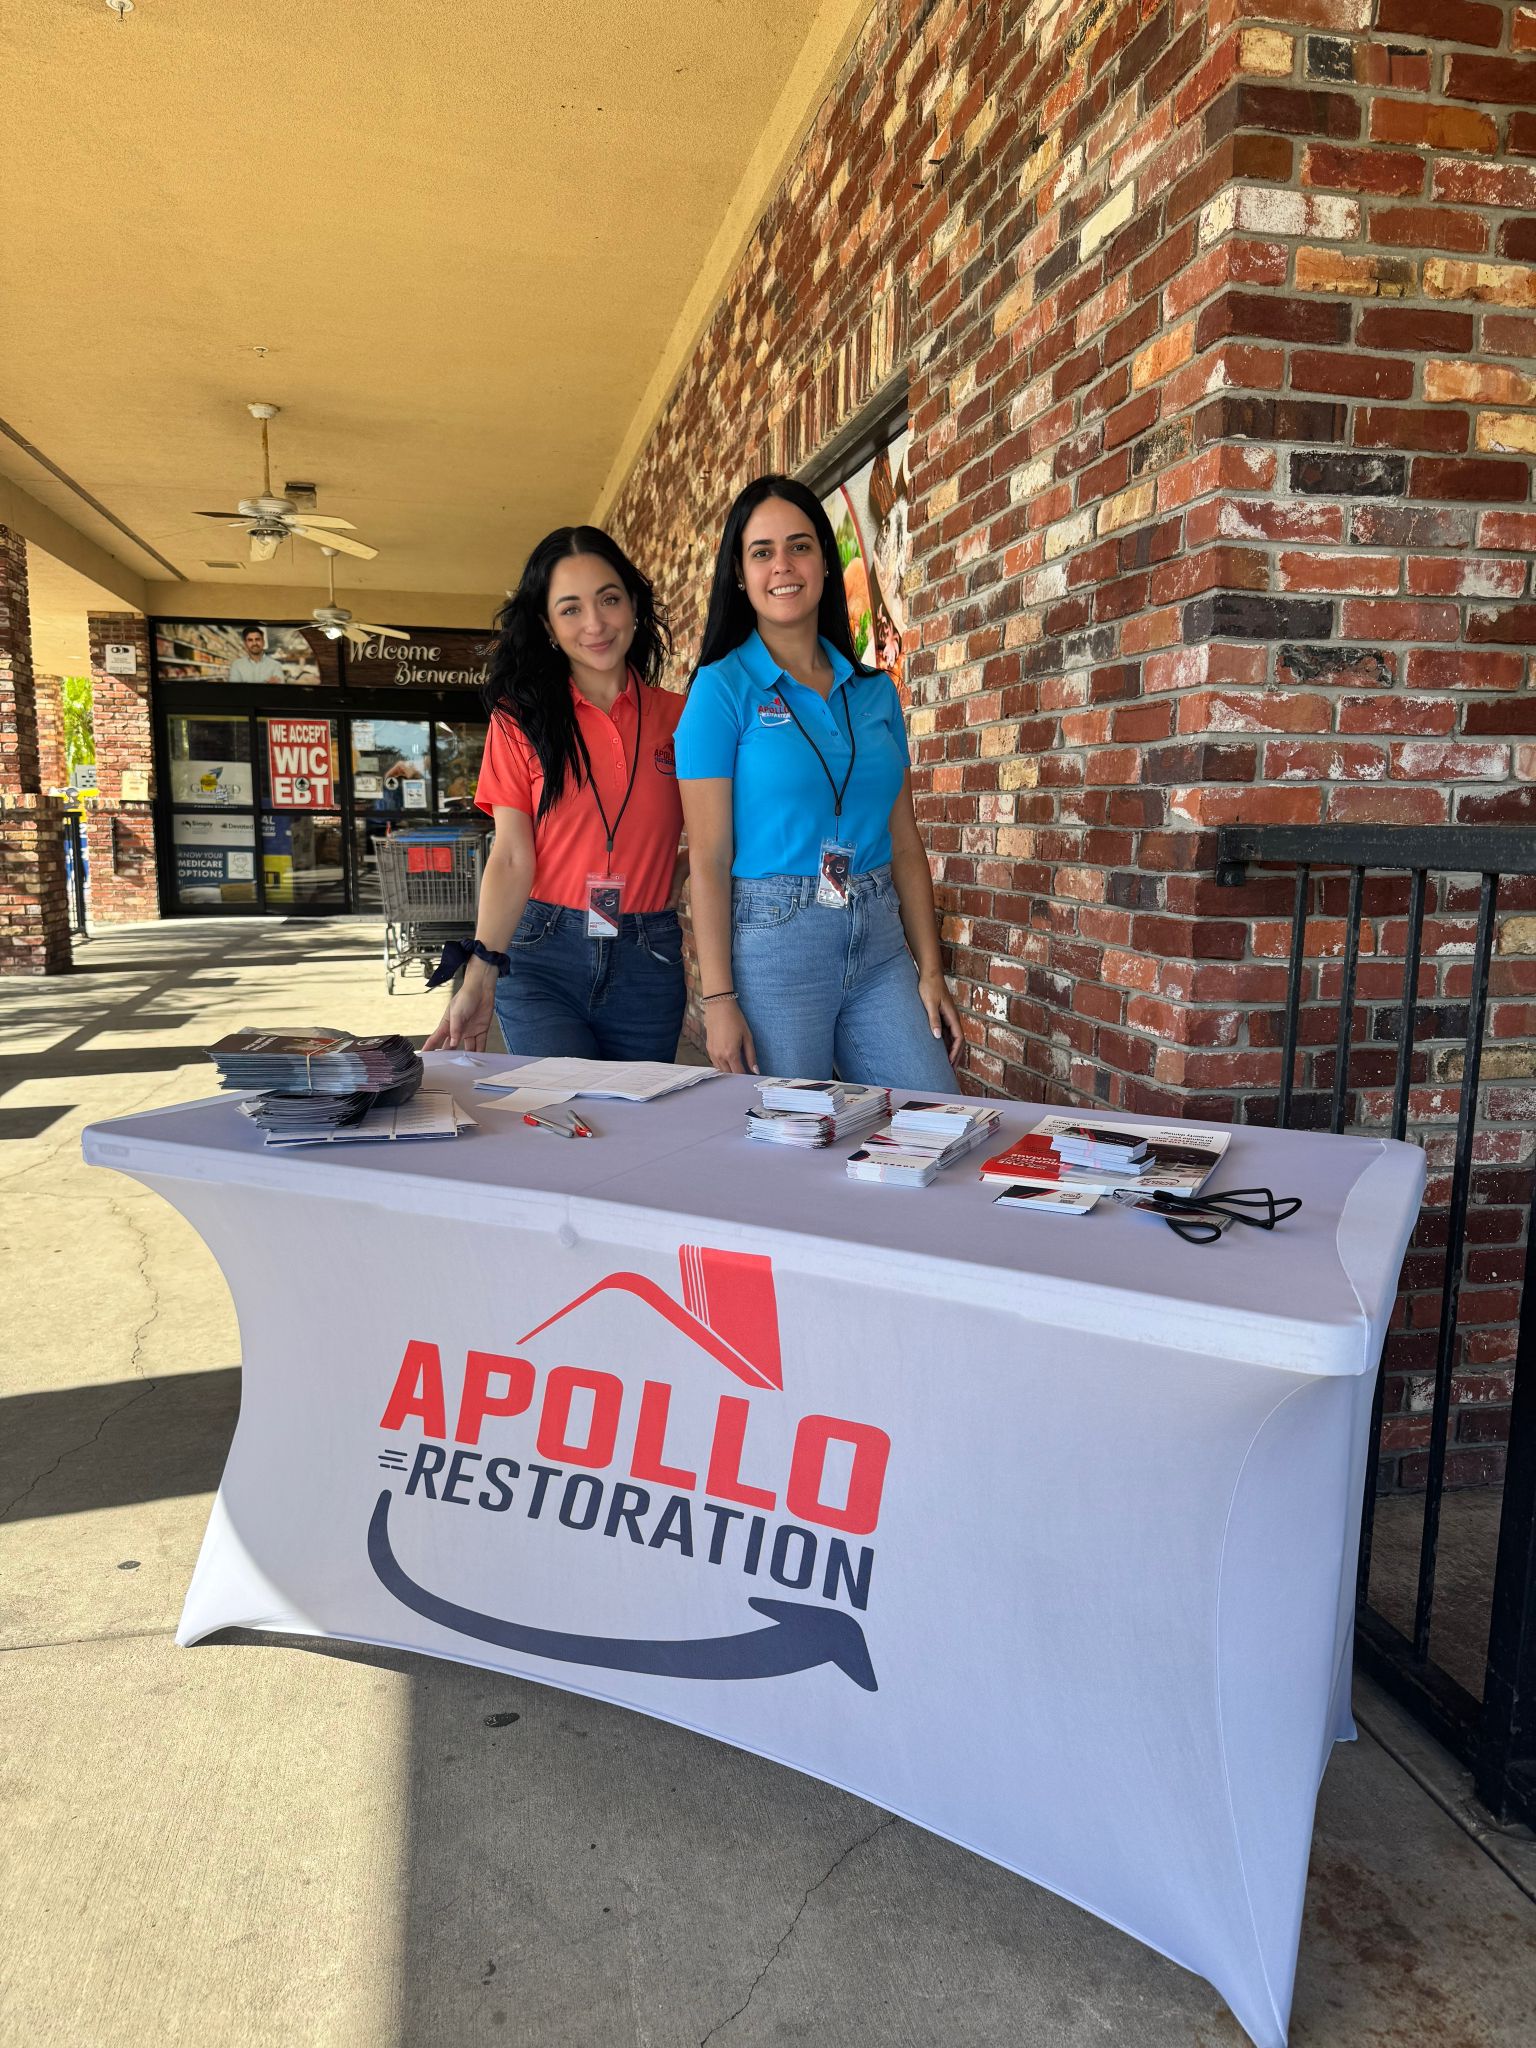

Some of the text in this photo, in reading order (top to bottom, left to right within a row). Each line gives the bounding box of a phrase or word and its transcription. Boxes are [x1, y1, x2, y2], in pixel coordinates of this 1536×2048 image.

[350, 634, 442, 664] Welcome
[394, 661, 491, 686] Bienvenid
[271, 724, 327, 744] WE ACCEPT
[274, 746, 329, 775] WIC
[274, 777, 329, 805] EBT
[178, 860, 224, 868] MEDICARE
[178, 869, 224, 878] OPTIONS
[380, 1339, 891, 1536] APOLLO
[405, 1443, 875, 1611] RESTORATION
